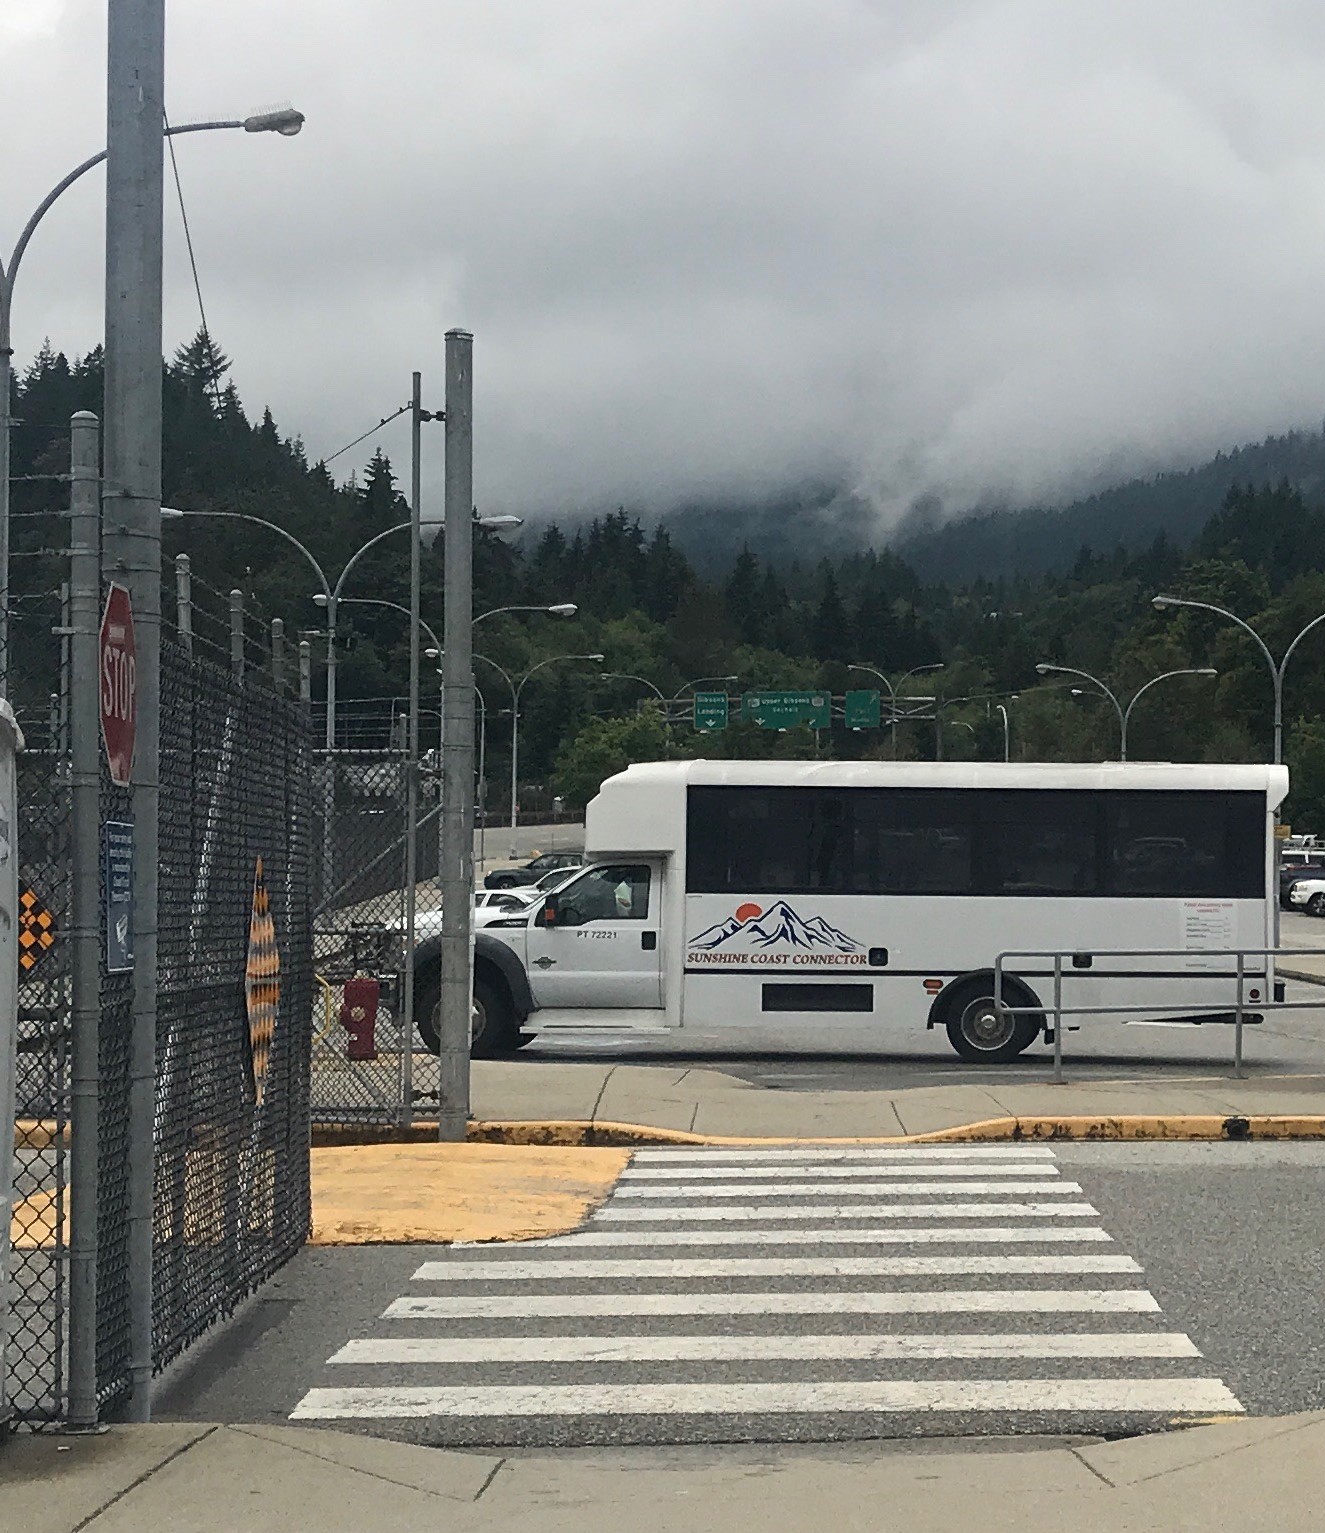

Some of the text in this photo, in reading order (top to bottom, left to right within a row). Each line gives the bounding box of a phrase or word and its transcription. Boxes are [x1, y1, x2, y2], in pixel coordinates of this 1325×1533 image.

[103, 644, 135, 722] STOP
[576, 930, 617, 939] PT 72221
[687, 952, 867, 965] SUNSHINE COAST CONNECTOR
